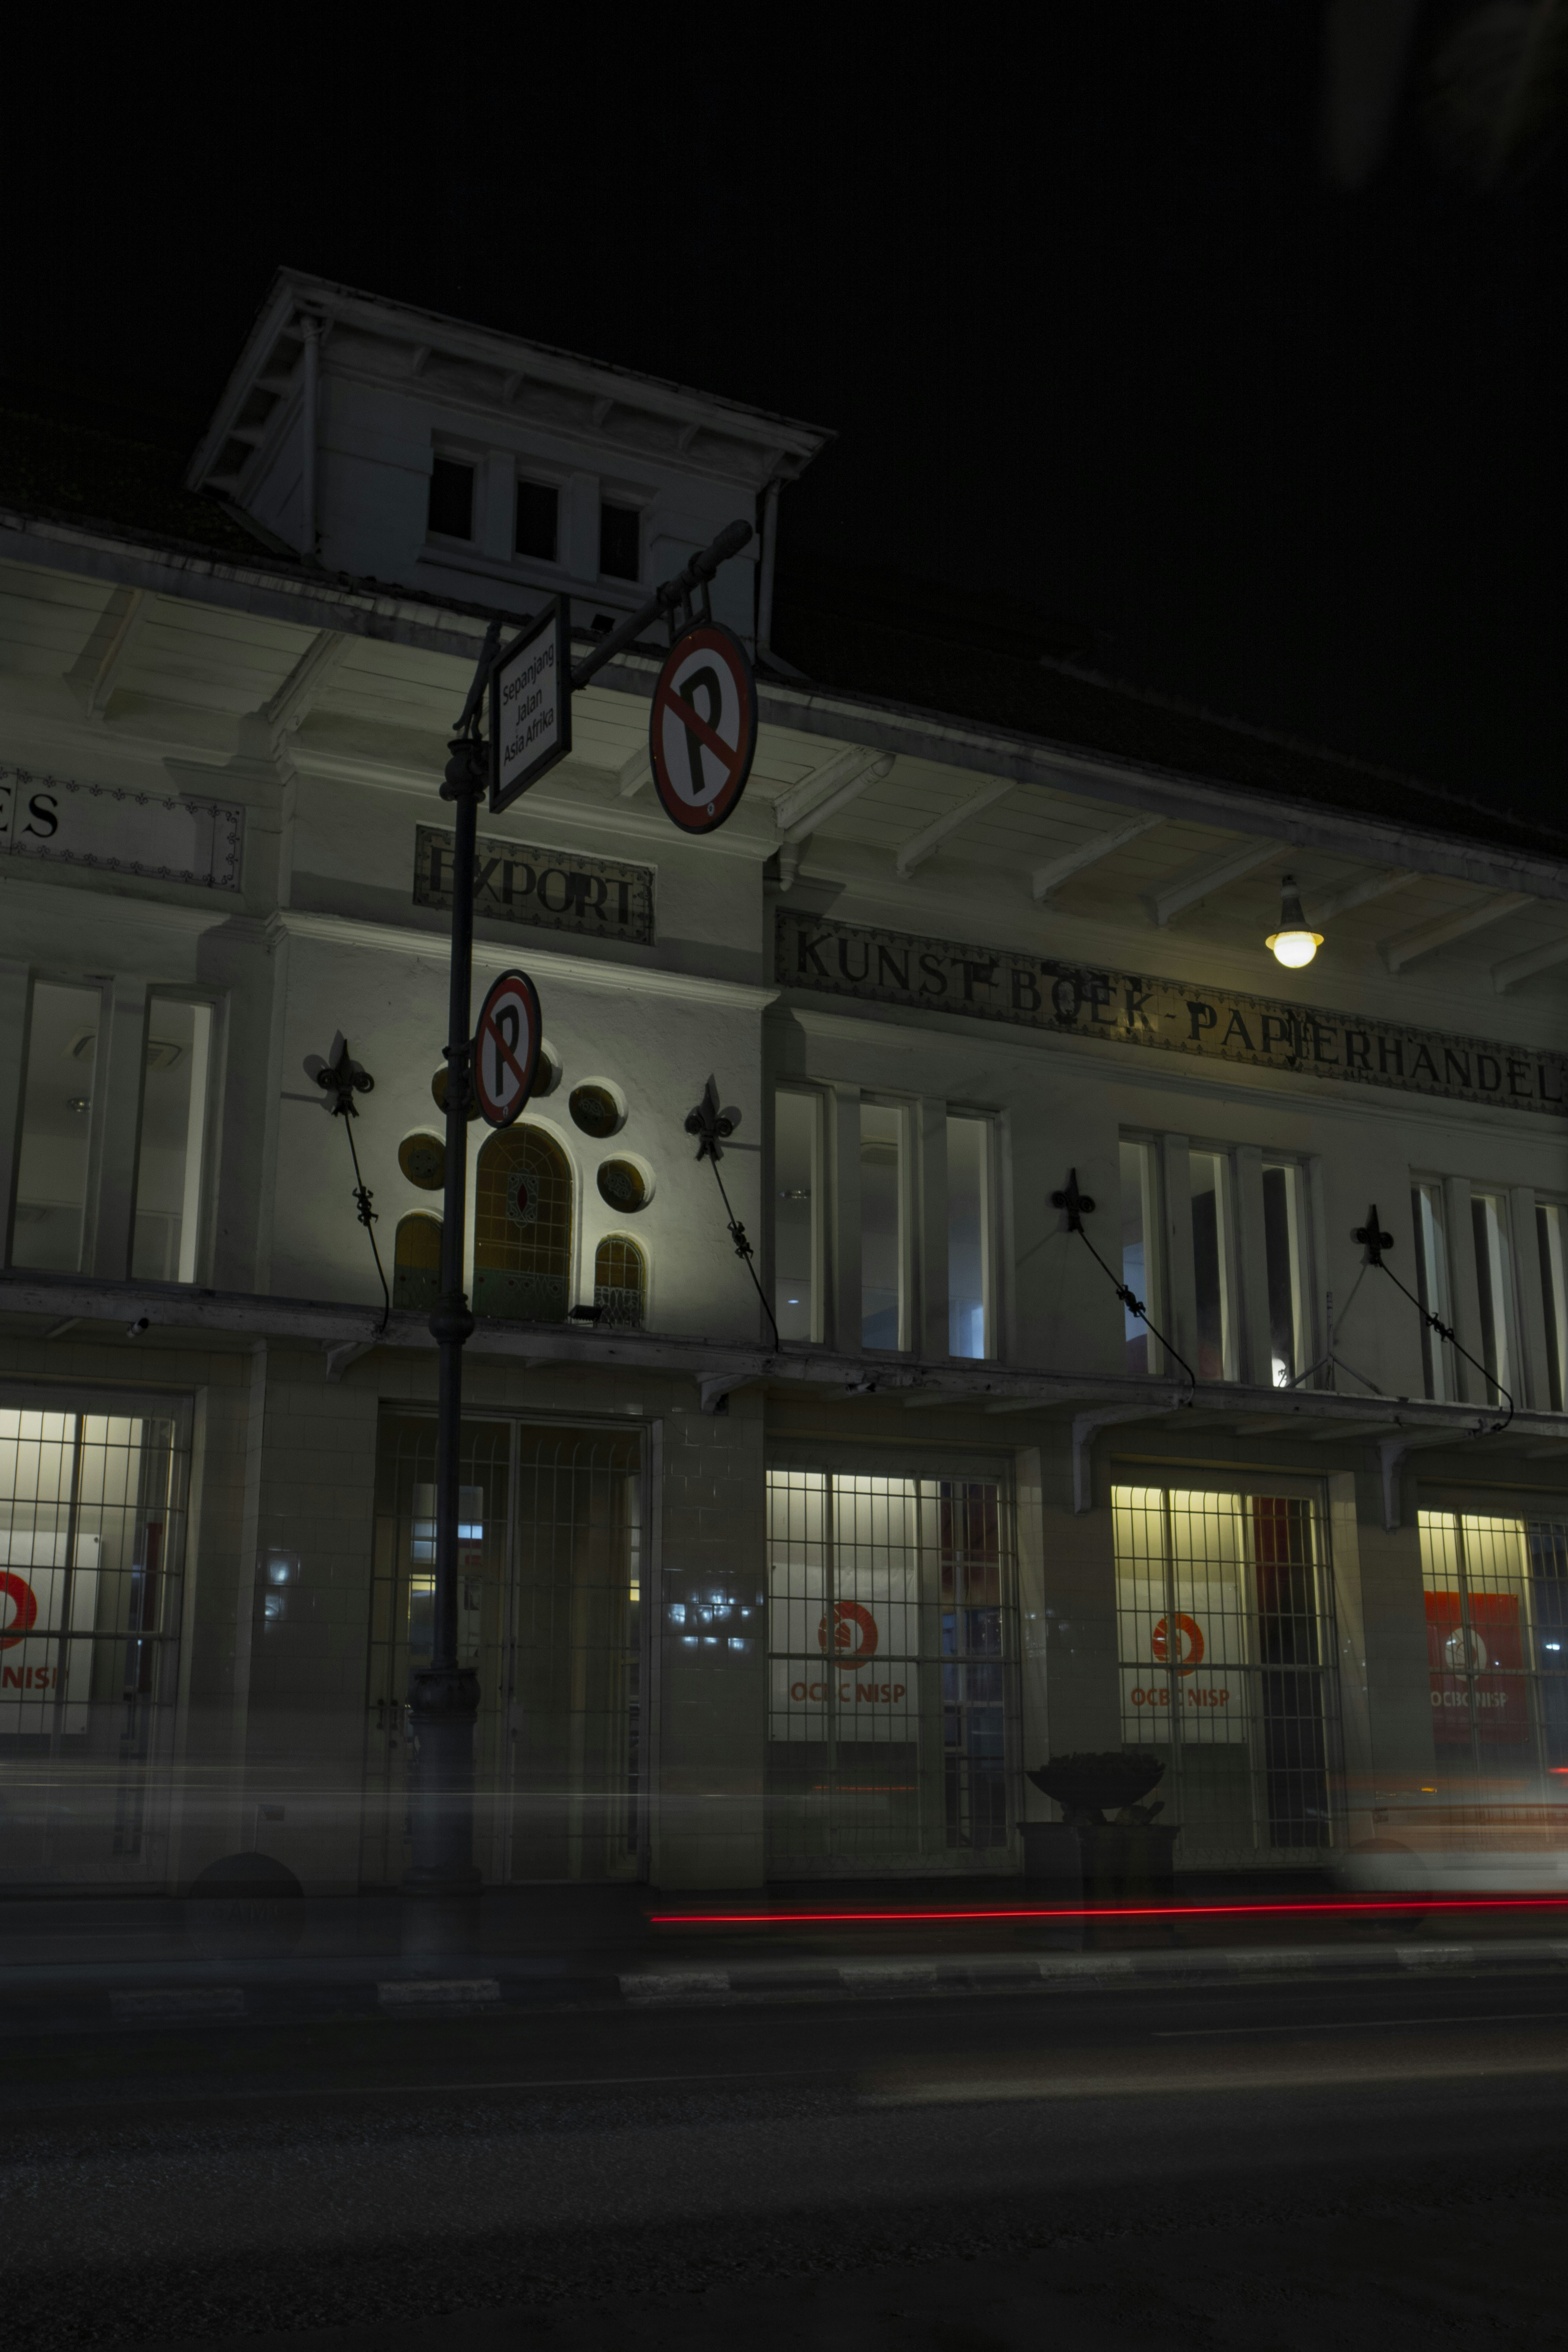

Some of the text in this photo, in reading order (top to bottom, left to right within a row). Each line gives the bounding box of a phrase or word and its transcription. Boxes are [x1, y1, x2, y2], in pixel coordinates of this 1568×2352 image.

[503, 644, 554, 705] Sepanjang
[516, 689, 542, 726] Jalan
[679, 666, 722, 796] P
[504, 708, 554, 766] Asia Afrika
[0, 786, 58, 838] S
[495, 1004, 519, 1098] P
[856, 1684, 906, 1703] NISP
[1187, 1689, 1230, 1707] NISP
